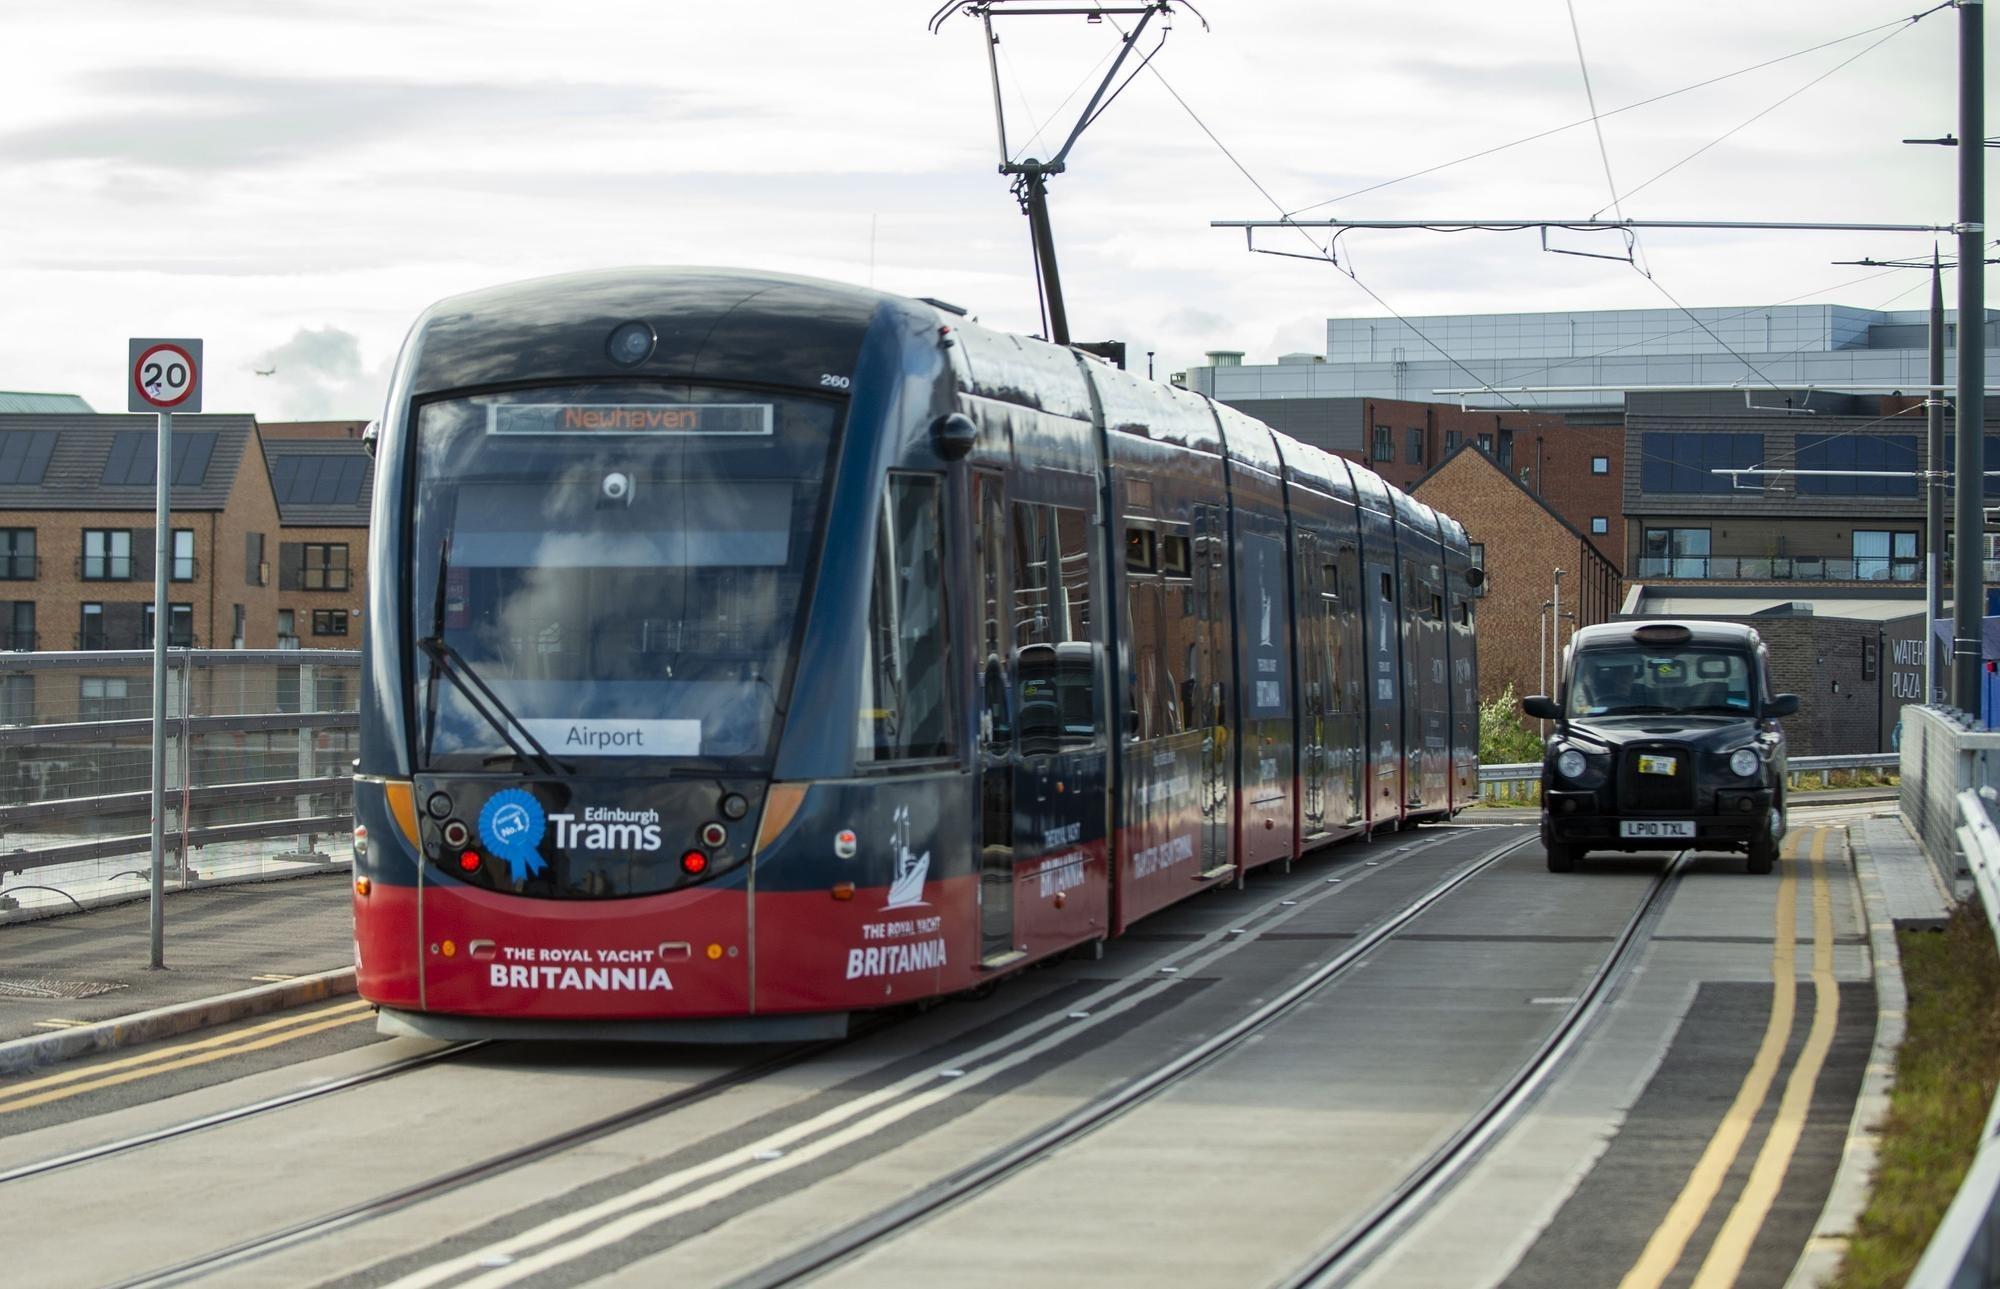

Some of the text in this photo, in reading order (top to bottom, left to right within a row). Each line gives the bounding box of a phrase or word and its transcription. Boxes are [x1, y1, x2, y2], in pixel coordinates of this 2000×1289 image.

[144, 363, 187, 388] 20
[820, 373, 850, 389] 260
[565, 406, 697, 428] Newhaven
[1892, 672, 1921, 698] PLAZA
[566, 726, 644, 750] Airport
[585, 807, 659, 826] Edinburgh
[548, 813, 662, 850] Trams
[1662, 823, 1688, 835] TXL
[863, 923, 886, 939] THE
[504, 947, 654, 962] THE ROYAL YACHT
[846, 938, 947, 979] BRITANNIA
[490, 964, 673, 990] BRITANNIA
